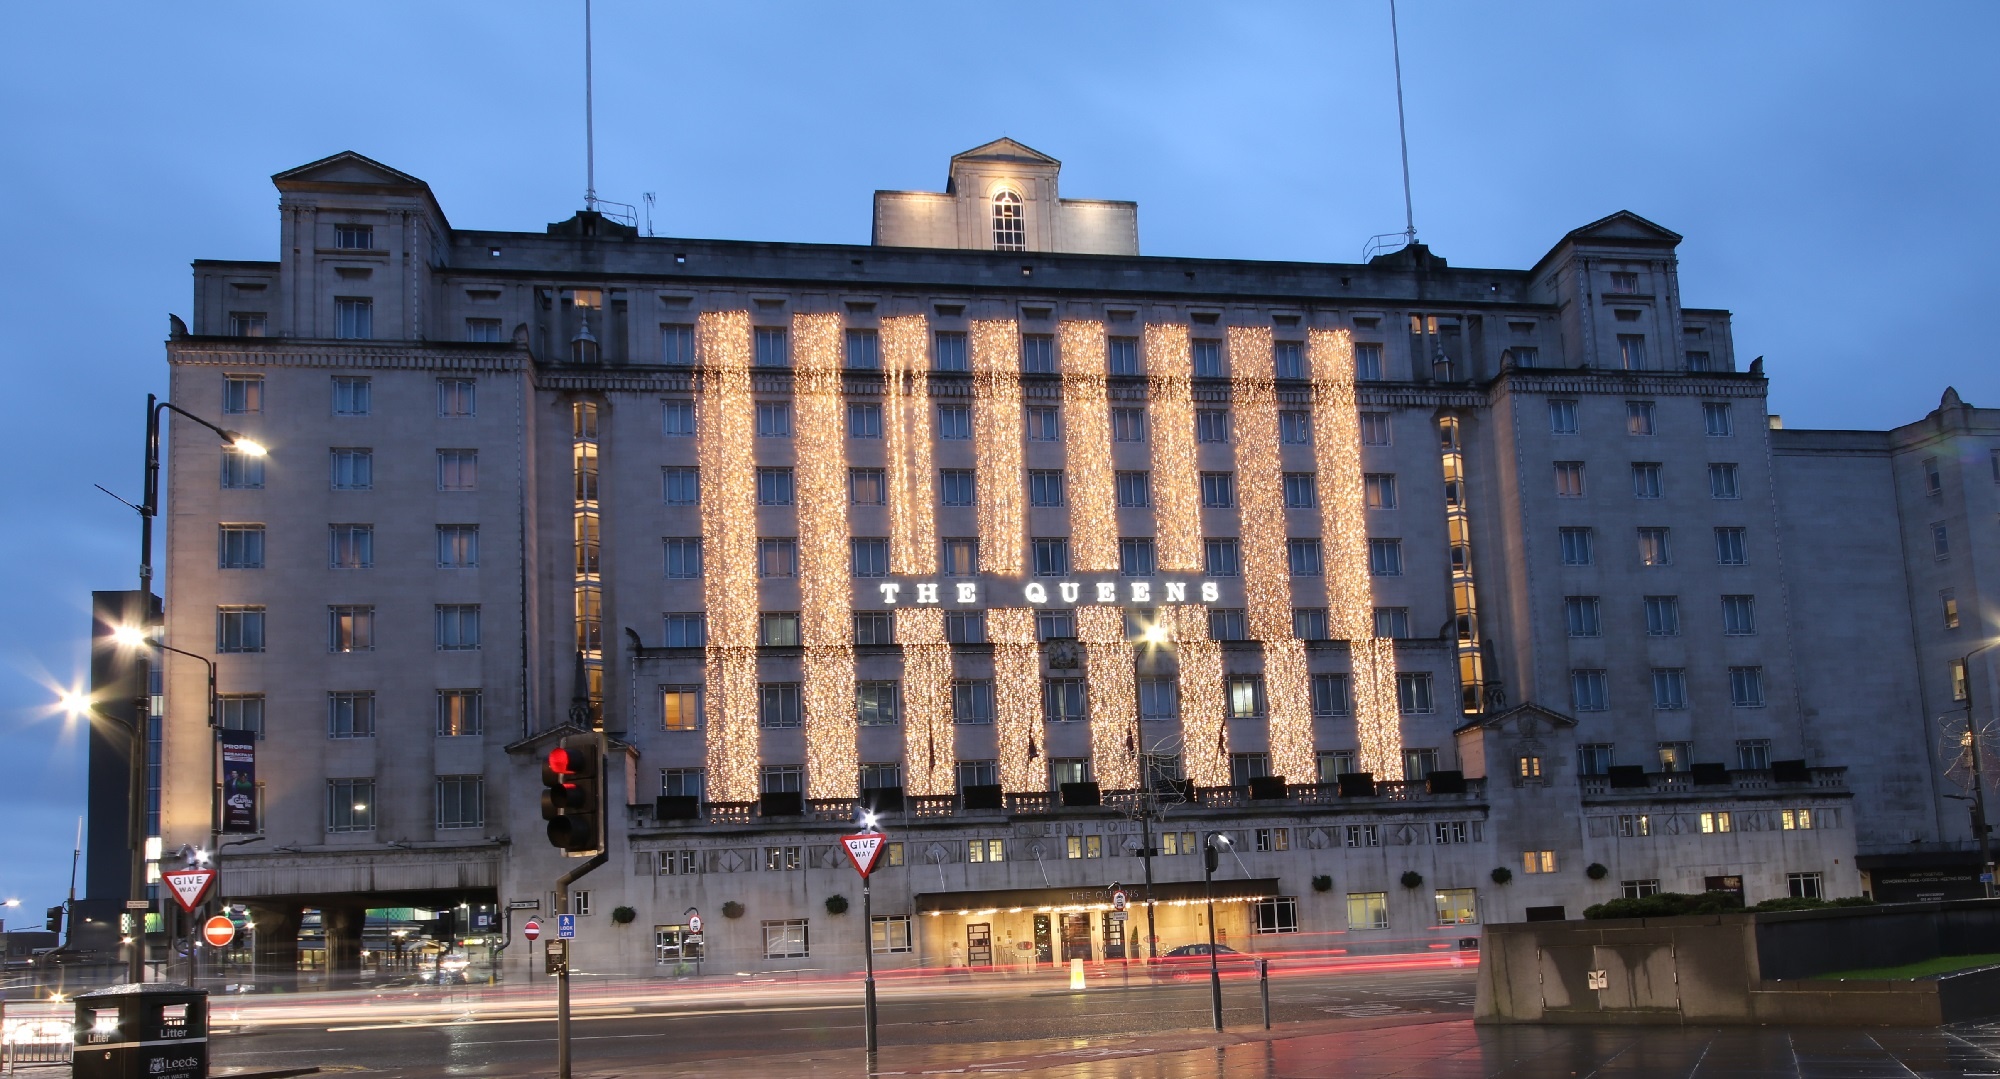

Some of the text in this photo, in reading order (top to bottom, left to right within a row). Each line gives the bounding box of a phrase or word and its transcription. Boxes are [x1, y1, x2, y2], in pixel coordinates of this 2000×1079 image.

[880, 582, 1219, 603] THE QUEENS
[1018, 822, 1084, 835] QUEENS
[851, 840, 875, 849] GIVE
[174, 876, 203, 885] GIVE
[1069, 891, 1091, 900] THE
[160, 1028, 187, 1038] Litter
[88, 1034, 110, 1043] Litter
[166, 1057, 198, 1068] Leeds
